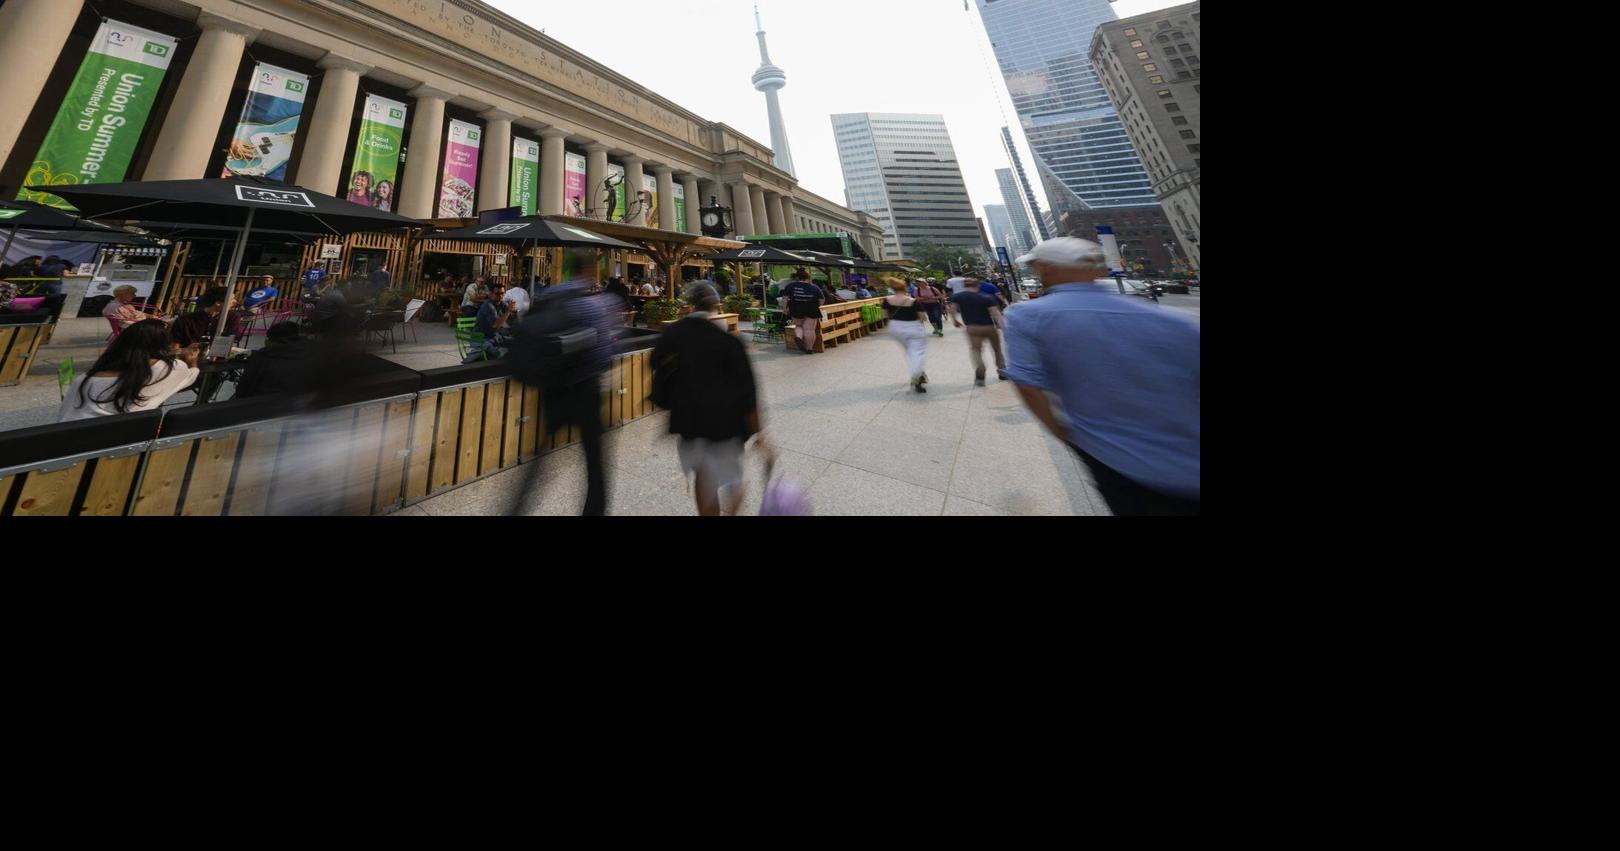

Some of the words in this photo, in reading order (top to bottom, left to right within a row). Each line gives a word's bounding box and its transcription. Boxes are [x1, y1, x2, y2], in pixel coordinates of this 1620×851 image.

[146, 42, 167, 57] TD
[88, 67, 116, 107] Presented
[107, 72, 144, 113] Union
[539, 51, 642, 106] STATION
[77, 118, 95, 132] TD
[81, 107, 100, 119] by
[80, 114, 126, 179] Summer
[522, 167, 532, 190] Union
